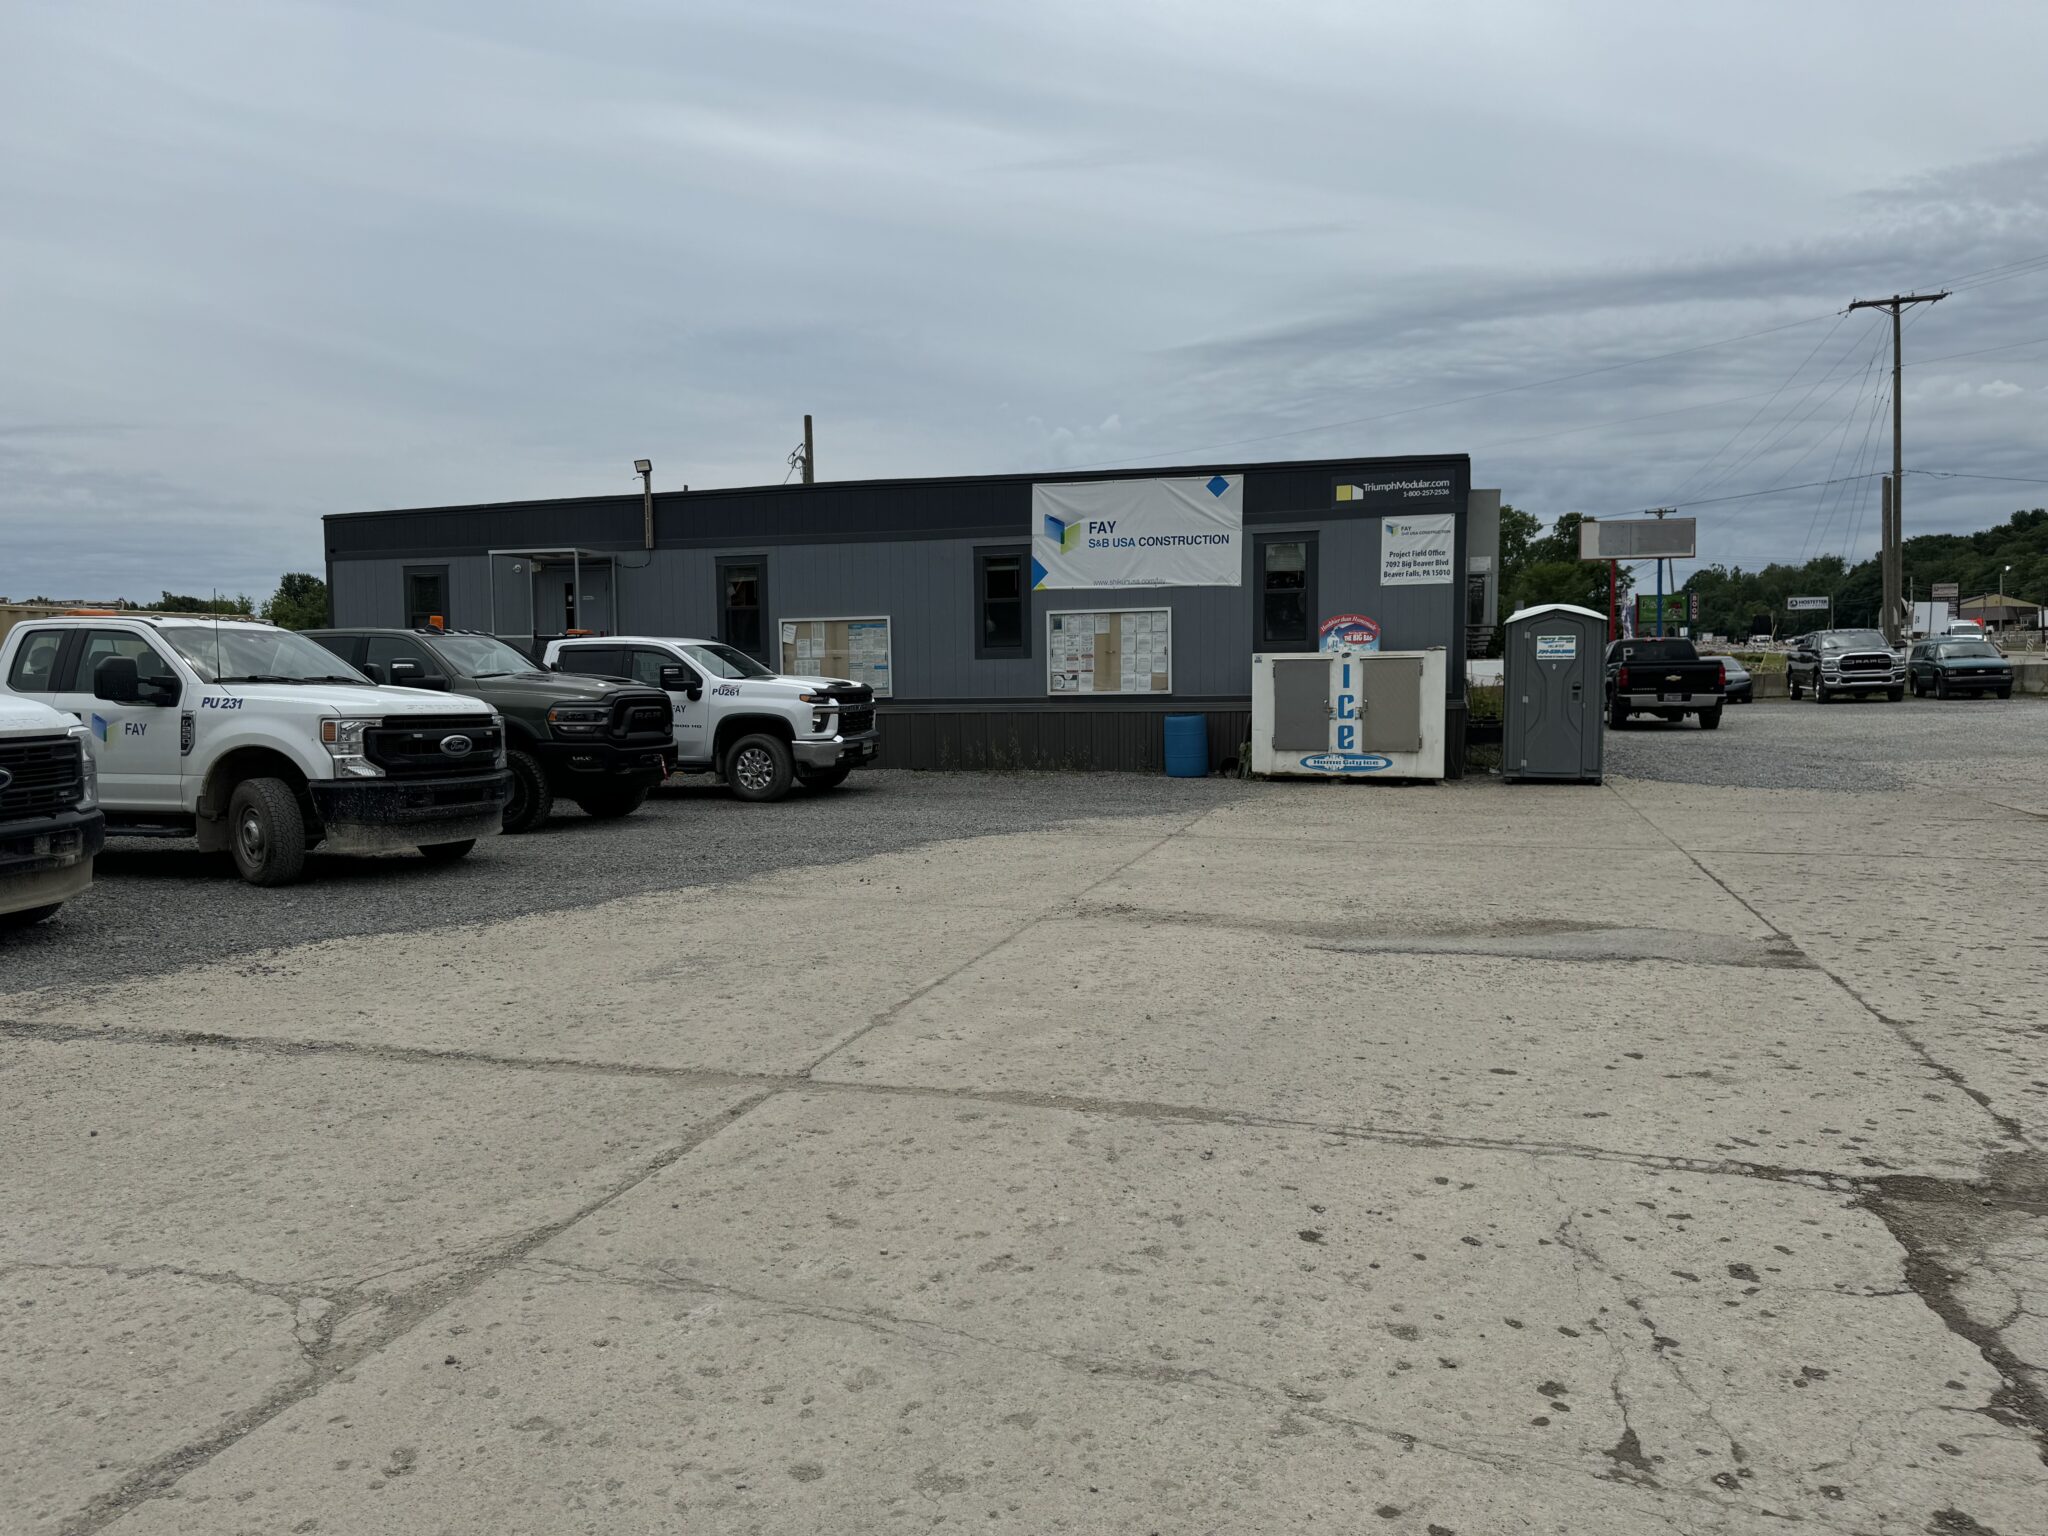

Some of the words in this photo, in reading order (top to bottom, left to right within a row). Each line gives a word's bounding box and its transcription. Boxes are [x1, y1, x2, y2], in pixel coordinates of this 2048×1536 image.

[1363, 480, 1450, 492] TriumphModular.com
[1403, 489, 1449, 498] 1-800-257-2536
[1089, 521, 1117, 534] FAY
[1088, 538, 1110, 549] S&B
[1112, 538, 1136, 548] USA
[1138, 534, 1230, 548] CONSTRUCTION
[1389, 550, 1411, 559] Project
[1386, 560, 1400, 568] 7092
[1402, 560, 1412, 569] Big
[1431, 568, 1451, 576] 15010
[712, 688, 740, 697] PU261
[201, 697, 220, 709] PU
[220, 697, 244, 710] 231
[125, 723, 148, 736] FAY
[450, 741, 467, 751] Ford
